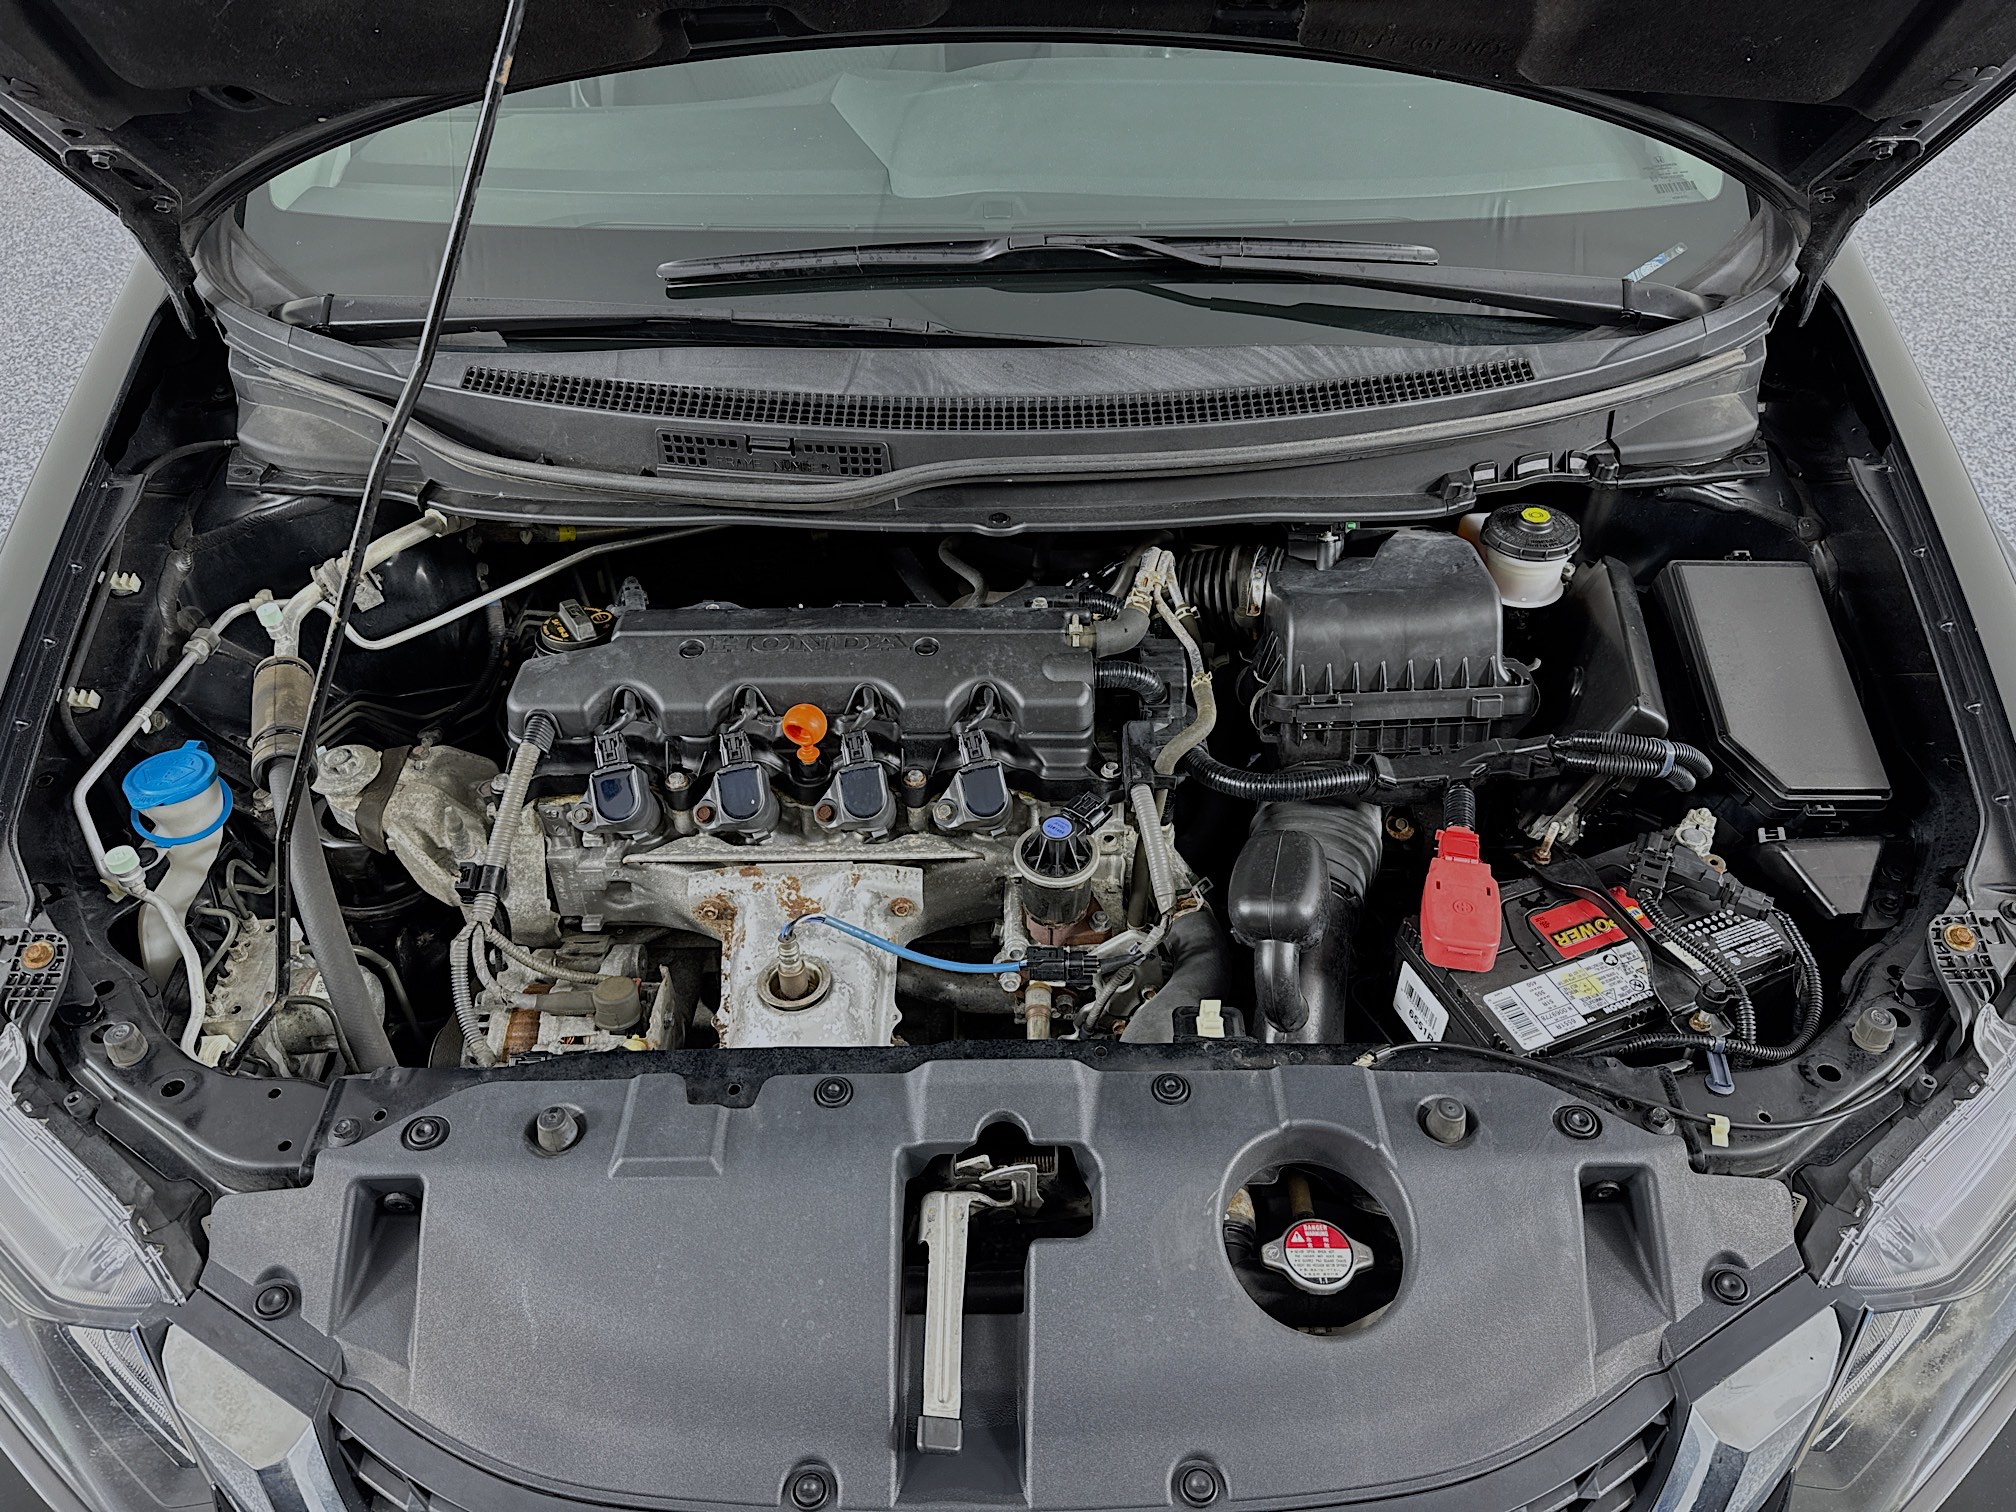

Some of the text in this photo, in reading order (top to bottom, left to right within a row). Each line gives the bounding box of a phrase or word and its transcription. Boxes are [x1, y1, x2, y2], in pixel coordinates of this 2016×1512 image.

[716, 456, 830, 473] FRAME NUMBER
[709, 635, 909, 653] HONDA
[1409, 1009, 1434, 1041] 6551R
[1554, 1018, 1576, 1029] 6551R
